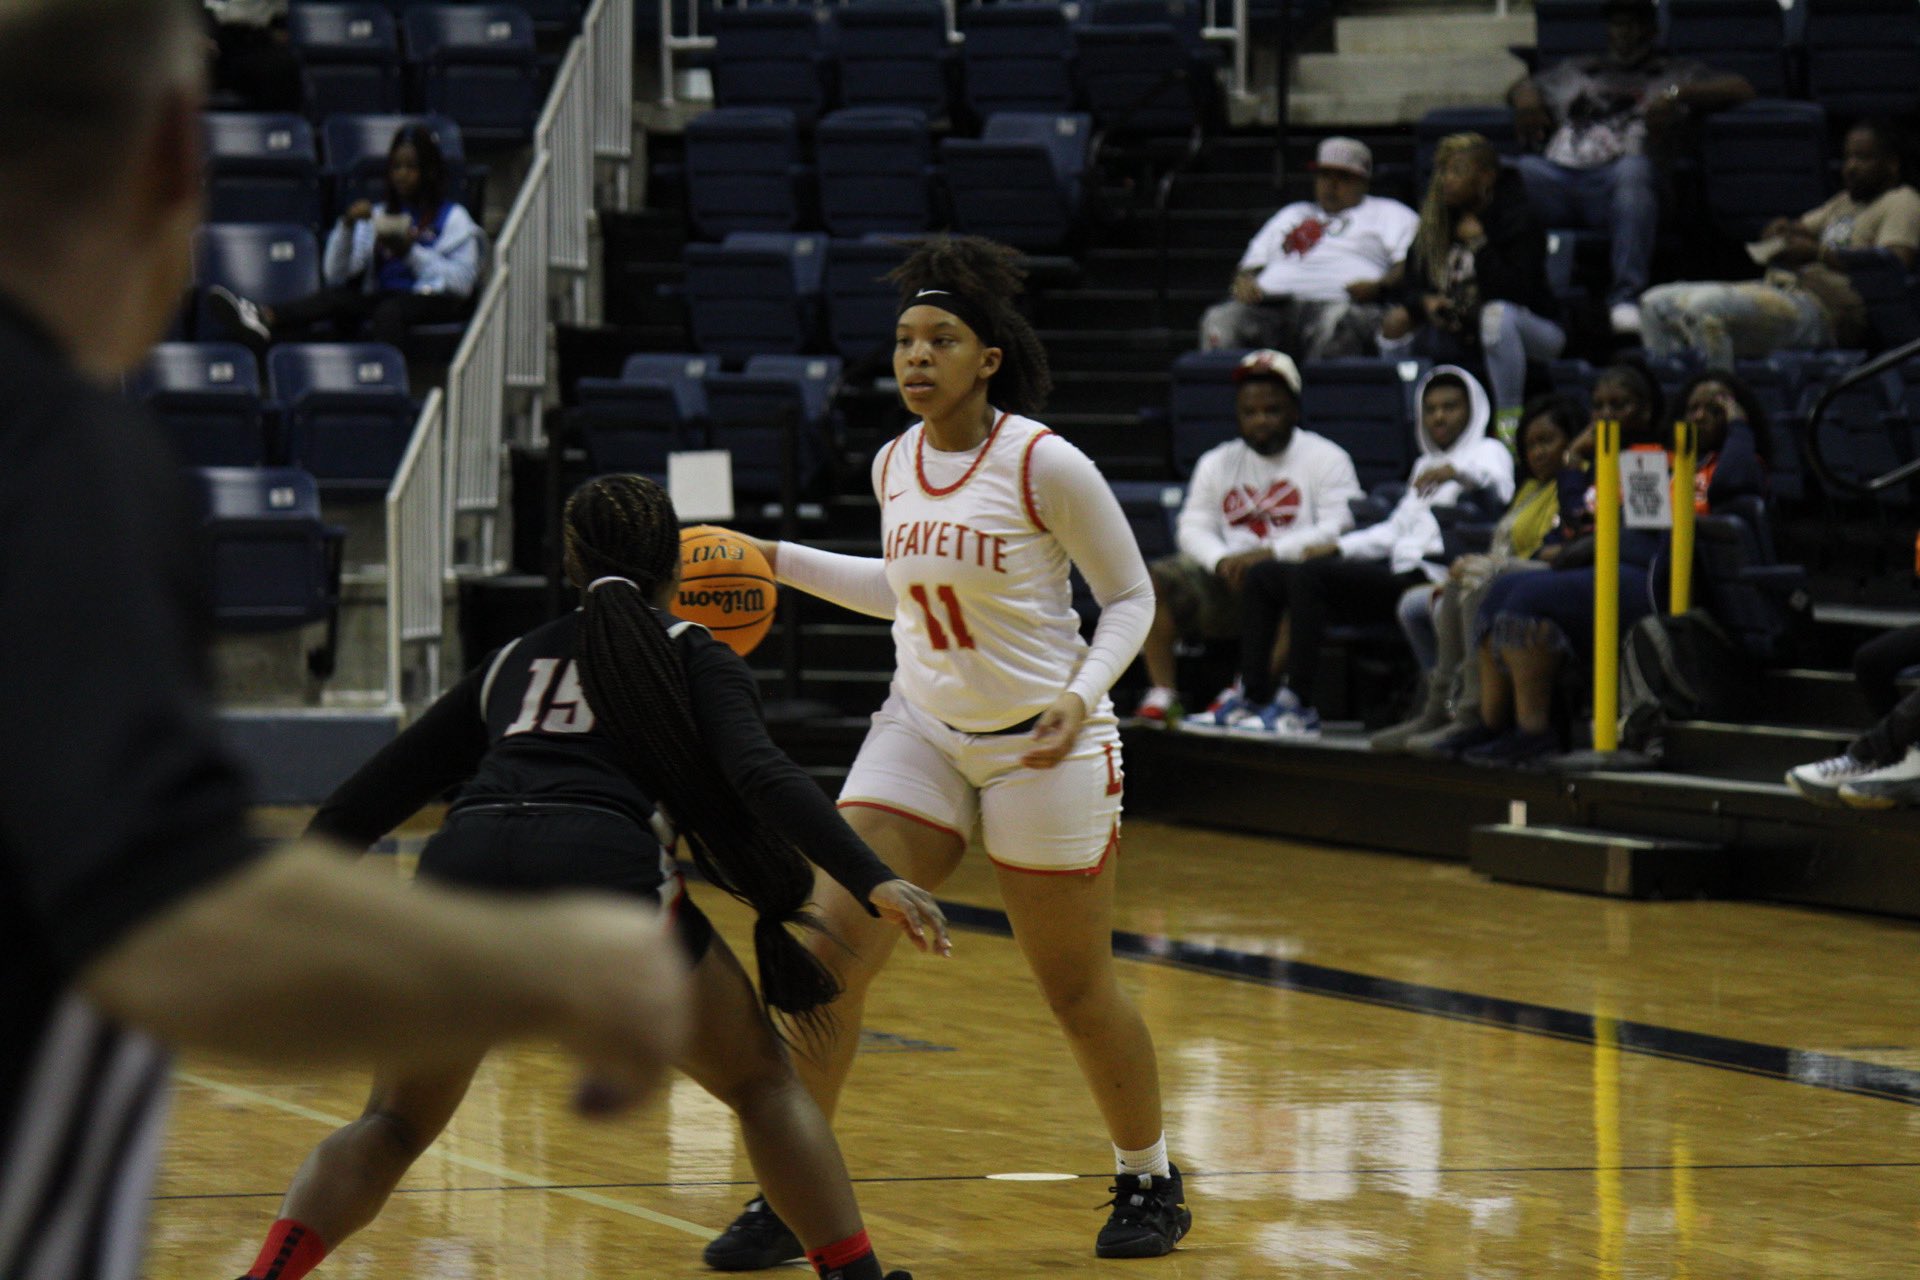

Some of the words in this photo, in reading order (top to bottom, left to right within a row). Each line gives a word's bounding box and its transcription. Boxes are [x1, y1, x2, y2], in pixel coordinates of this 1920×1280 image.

[680, 588, 764, 614] Wilson
[909, 585, 976, 650] 11
[503, 658, 596, 737] 15
